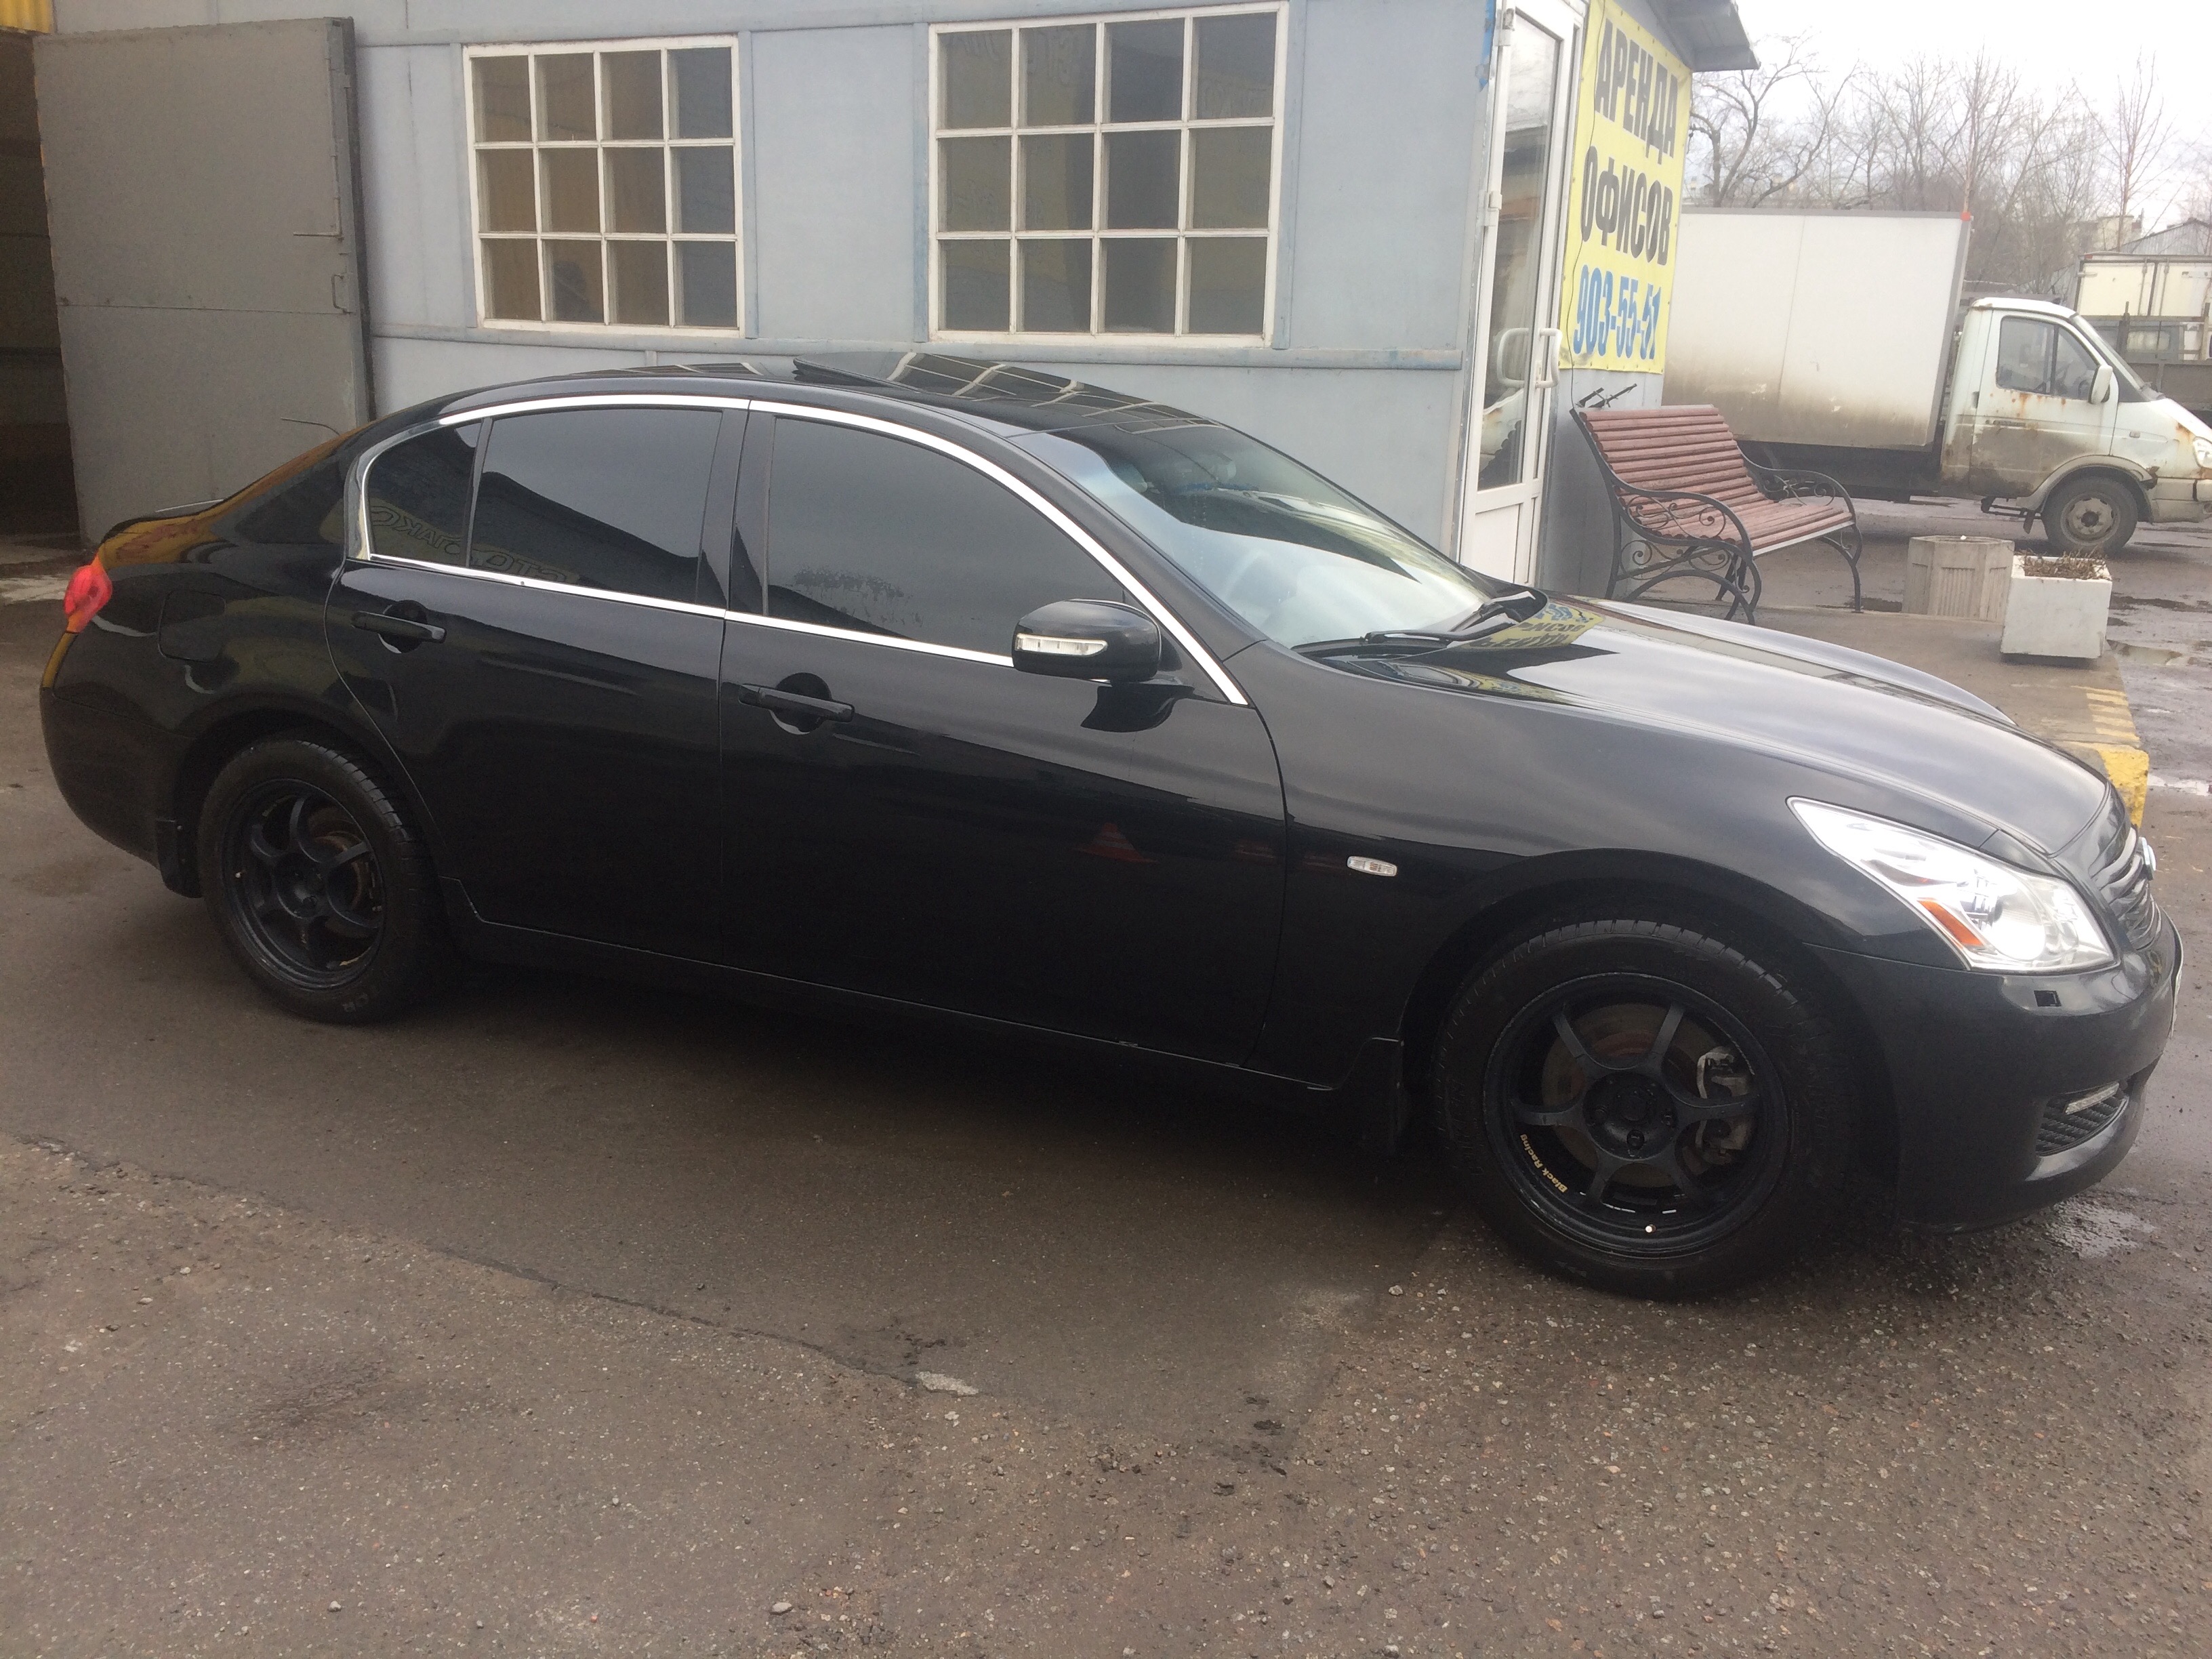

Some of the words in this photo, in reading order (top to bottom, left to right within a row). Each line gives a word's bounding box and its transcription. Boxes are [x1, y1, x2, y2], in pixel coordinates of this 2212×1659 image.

[1594, 18, 1678, 165] АРЕНДА
[1581, 145, 1673, 266] ОФИСОВ
[1573, 264, 1662, 360] 903-55-51
[1520, 1134, 1543, 1168] Racing
[1542, 1167, 1568, 1193] Black
